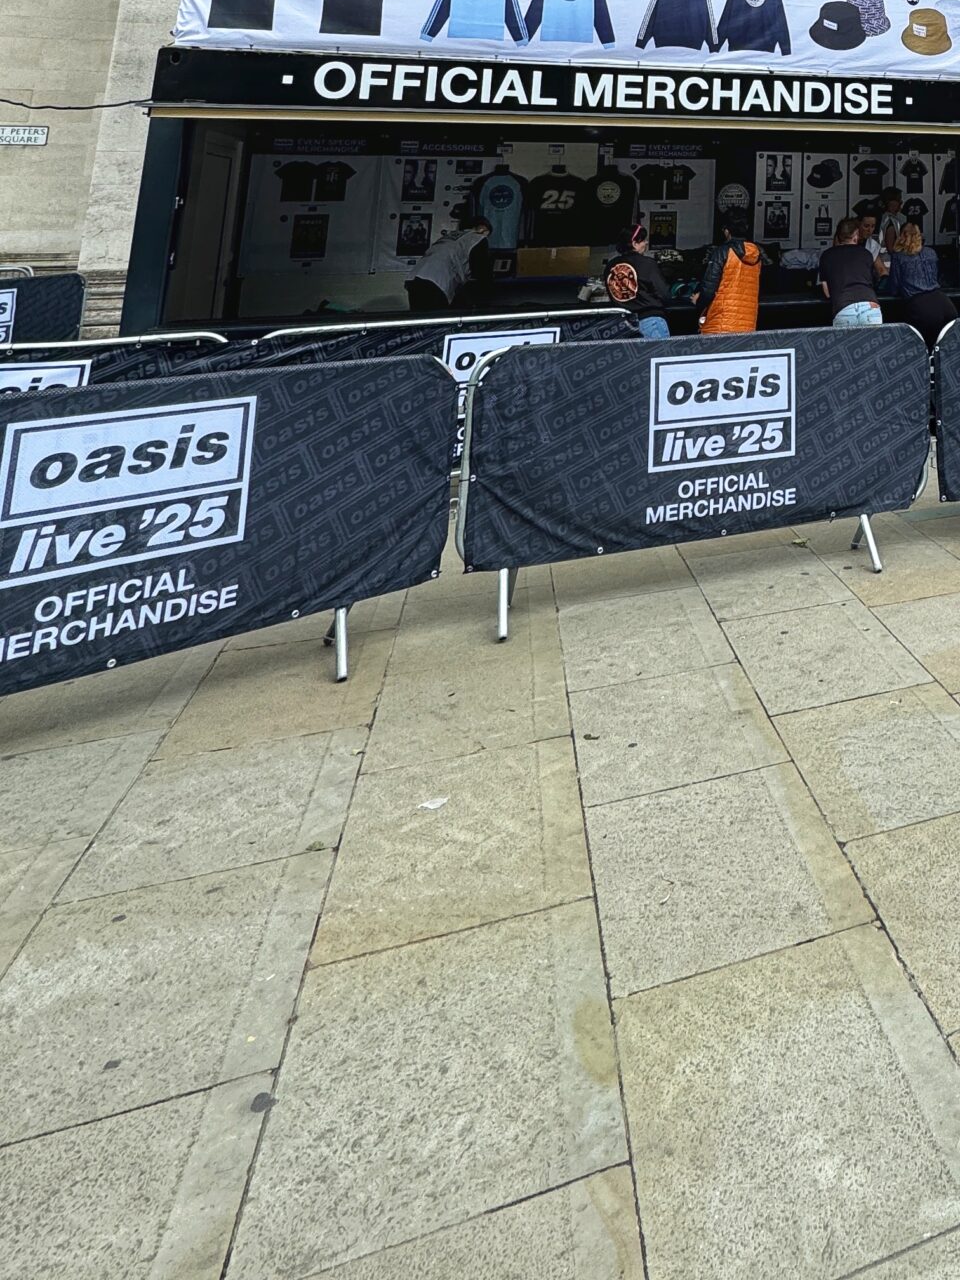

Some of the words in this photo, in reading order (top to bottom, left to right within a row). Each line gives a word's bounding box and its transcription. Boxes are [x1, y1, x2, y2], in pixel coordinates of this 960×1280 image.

[313, 61, 556, 106] OFFICIAL
[574, 66, 894, 115] MERCHANDISE
[10, 128, 46, 136] PETERS
[422, 144, 484, 152] ACCESSORIES
[540, 190, 576, 210] 25
[667, 367, 781, 406] oasis
[30, 423, 230, 490] oasis
[661, 431, 726, 462] live
[677, 472, 770, 499] OFFICIAL
[646, 488, 796, 524] MERCHANDISE
[8, 524, 126, 574] live
[34, 568, 196, 623] OFFICIAL
